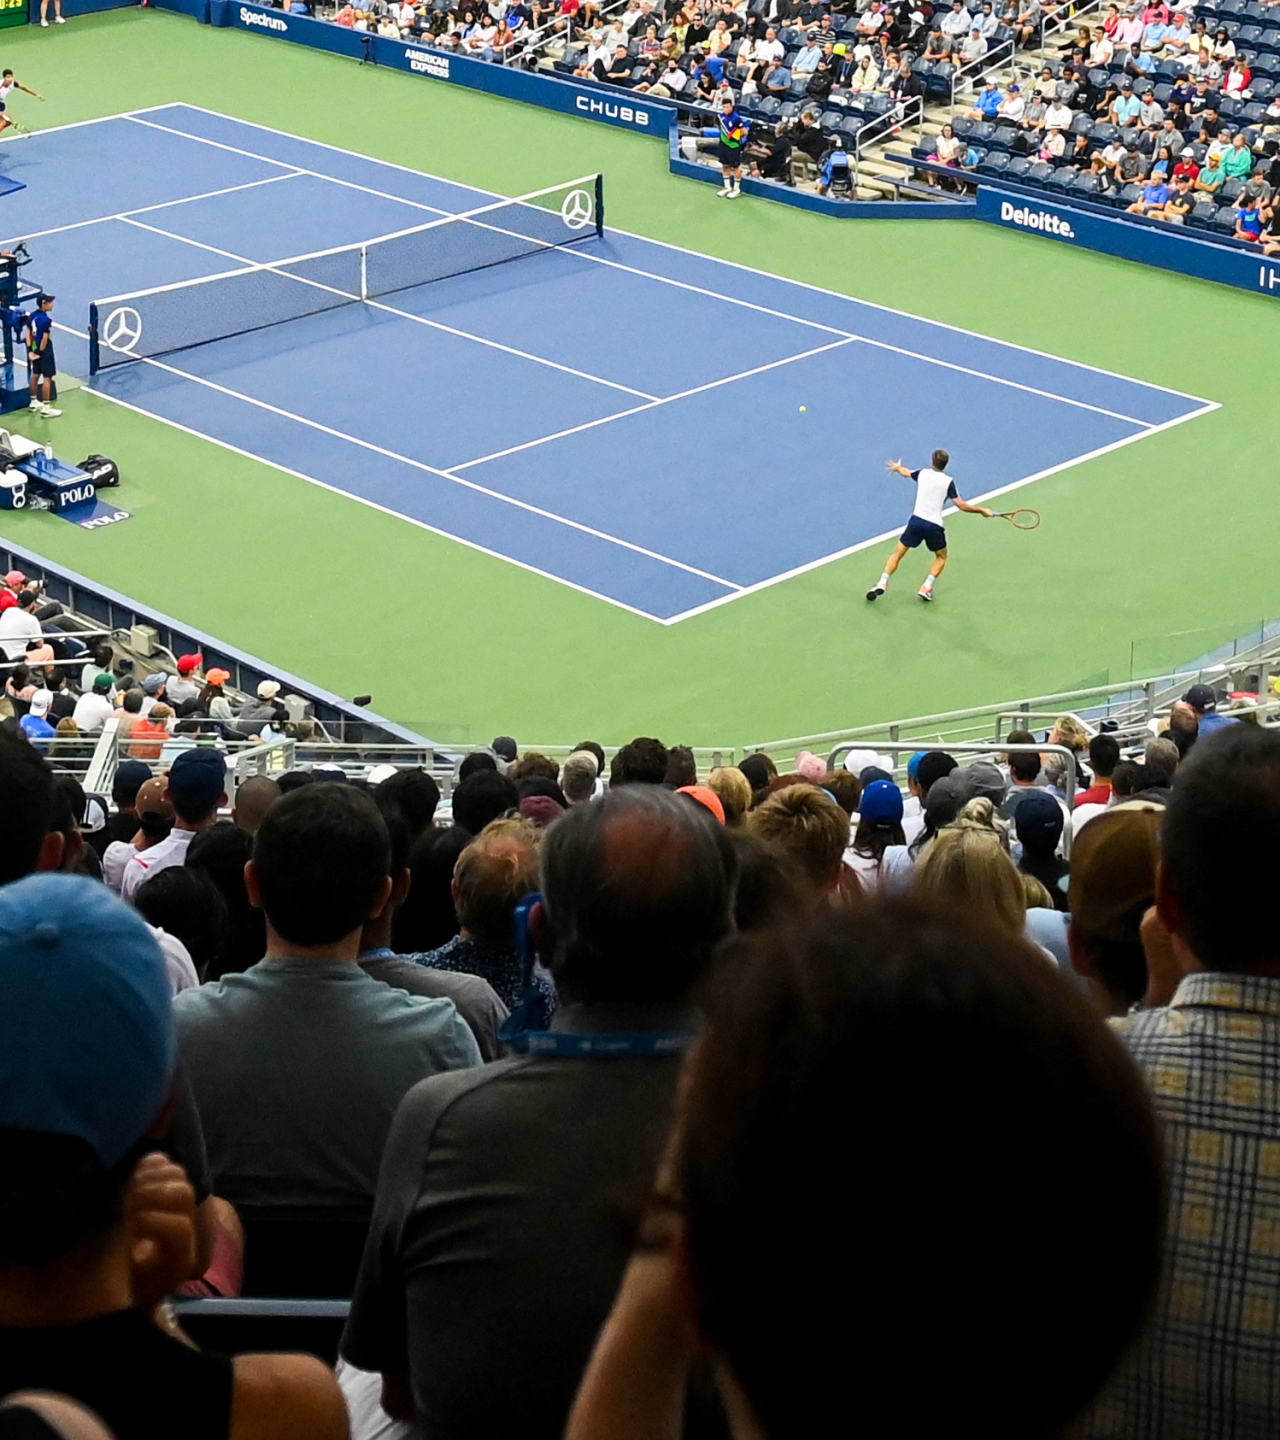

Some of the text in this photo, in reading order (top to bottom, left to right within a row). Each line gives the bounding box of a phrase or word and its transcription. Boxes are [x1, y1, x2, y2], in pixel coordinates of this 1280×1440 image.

[239, 6, 289, 32] Spectrum
[404, 48, 450, 69] AMERICAN
[410, 59, 450, 79] EXPRESS
[575, 95, 650, 127] CHUBB
[1000, 200, 1075, 239] Deloitte.
[59, 483, 95, 506] POLO
[81, 510, 131, 530] POLO
